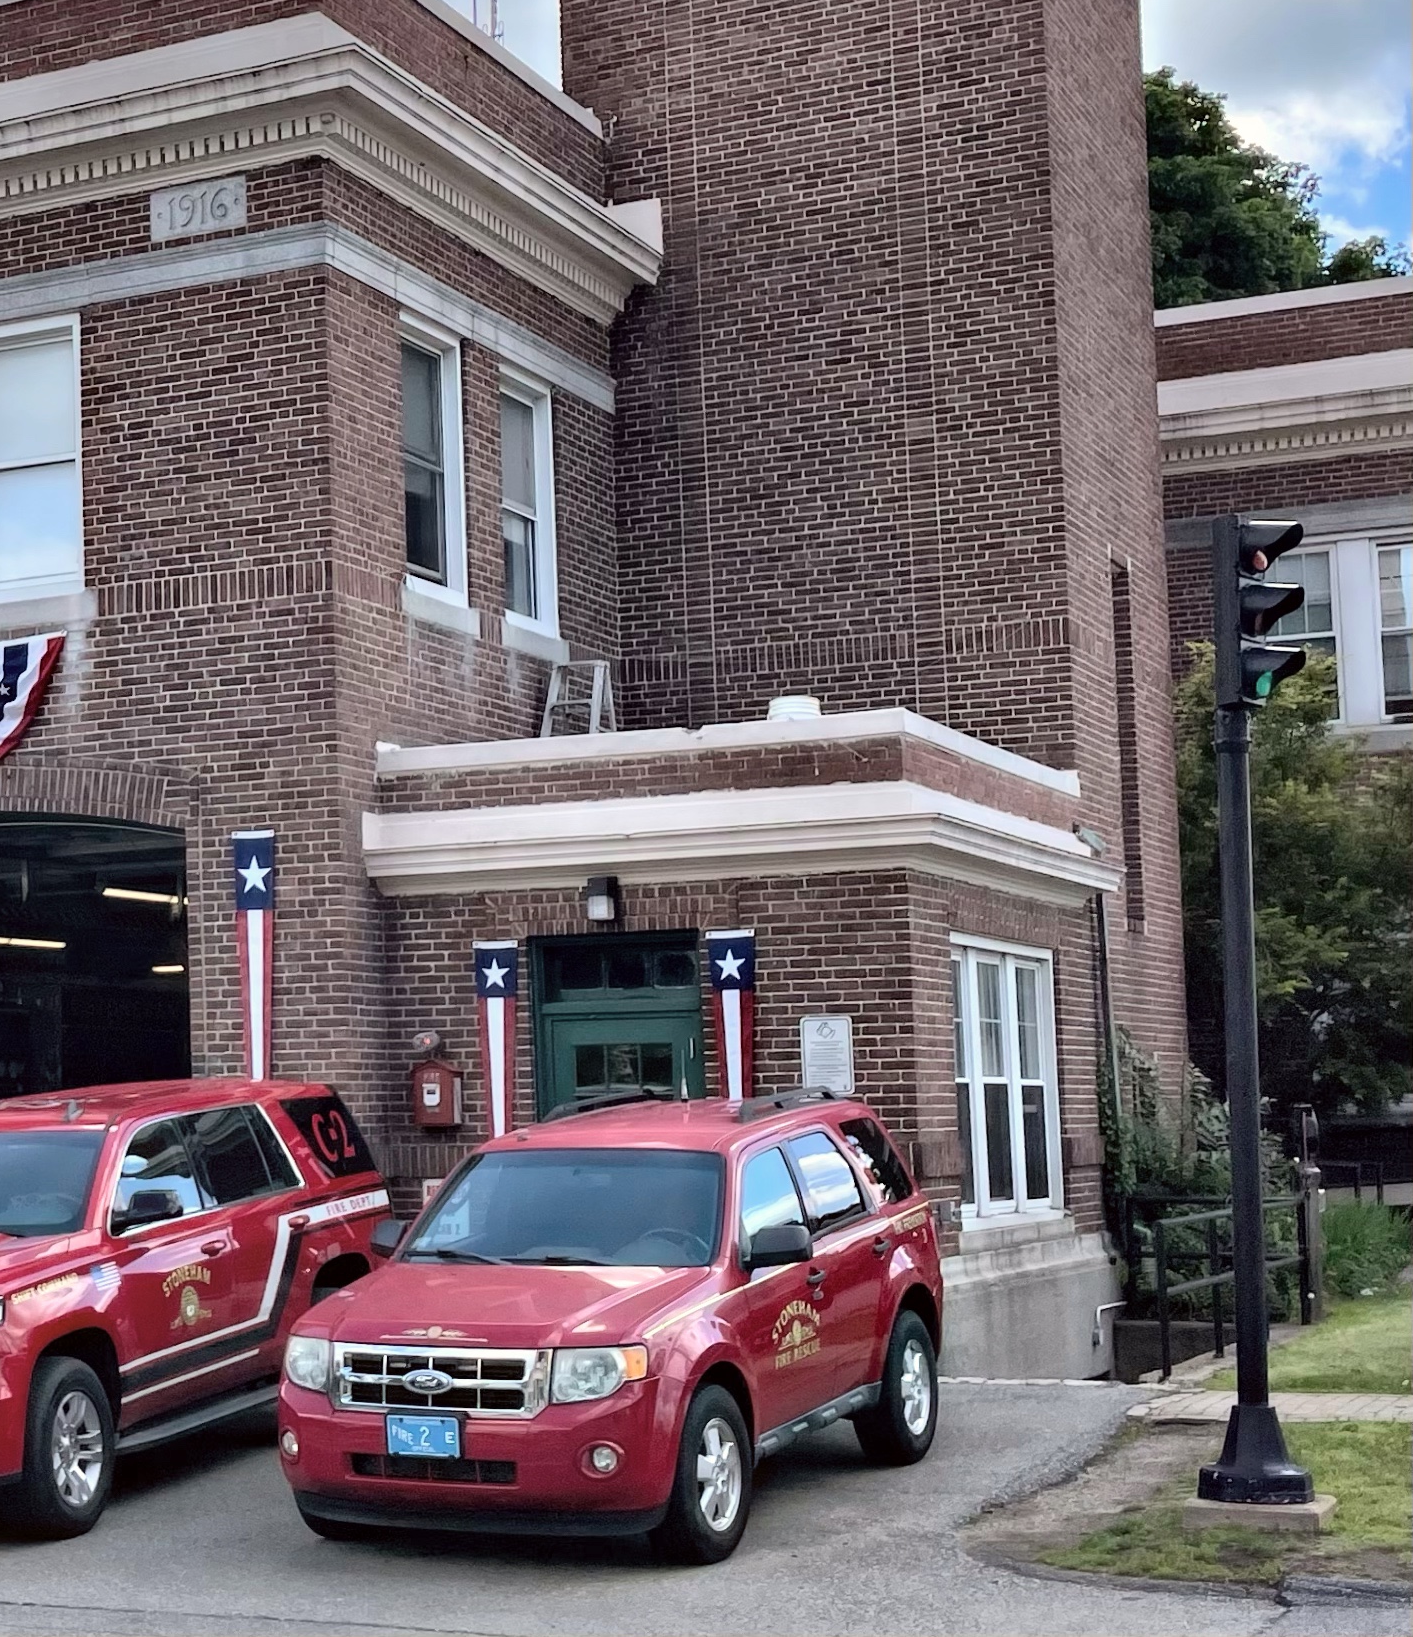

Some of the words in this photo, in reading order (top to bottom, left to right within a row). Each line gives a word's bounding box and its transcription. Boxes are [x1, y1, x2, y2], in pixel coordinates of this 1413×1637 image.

[167, 186, 229, 231] 1916
[311, 1110, 356, 1163] C-2
[326, 1201, 346, 1217] FIRE
[350, 1195, 371, 1211] DEPT
[161, 1264, 211, 1298] STONEHAM
[771, 1299, 821, 1345] STONEHAM
[391, 1424, 414, 1446] FIRE
[419, 1425, 431, 1447] 2
[444, 1431, 455, 1444] E
